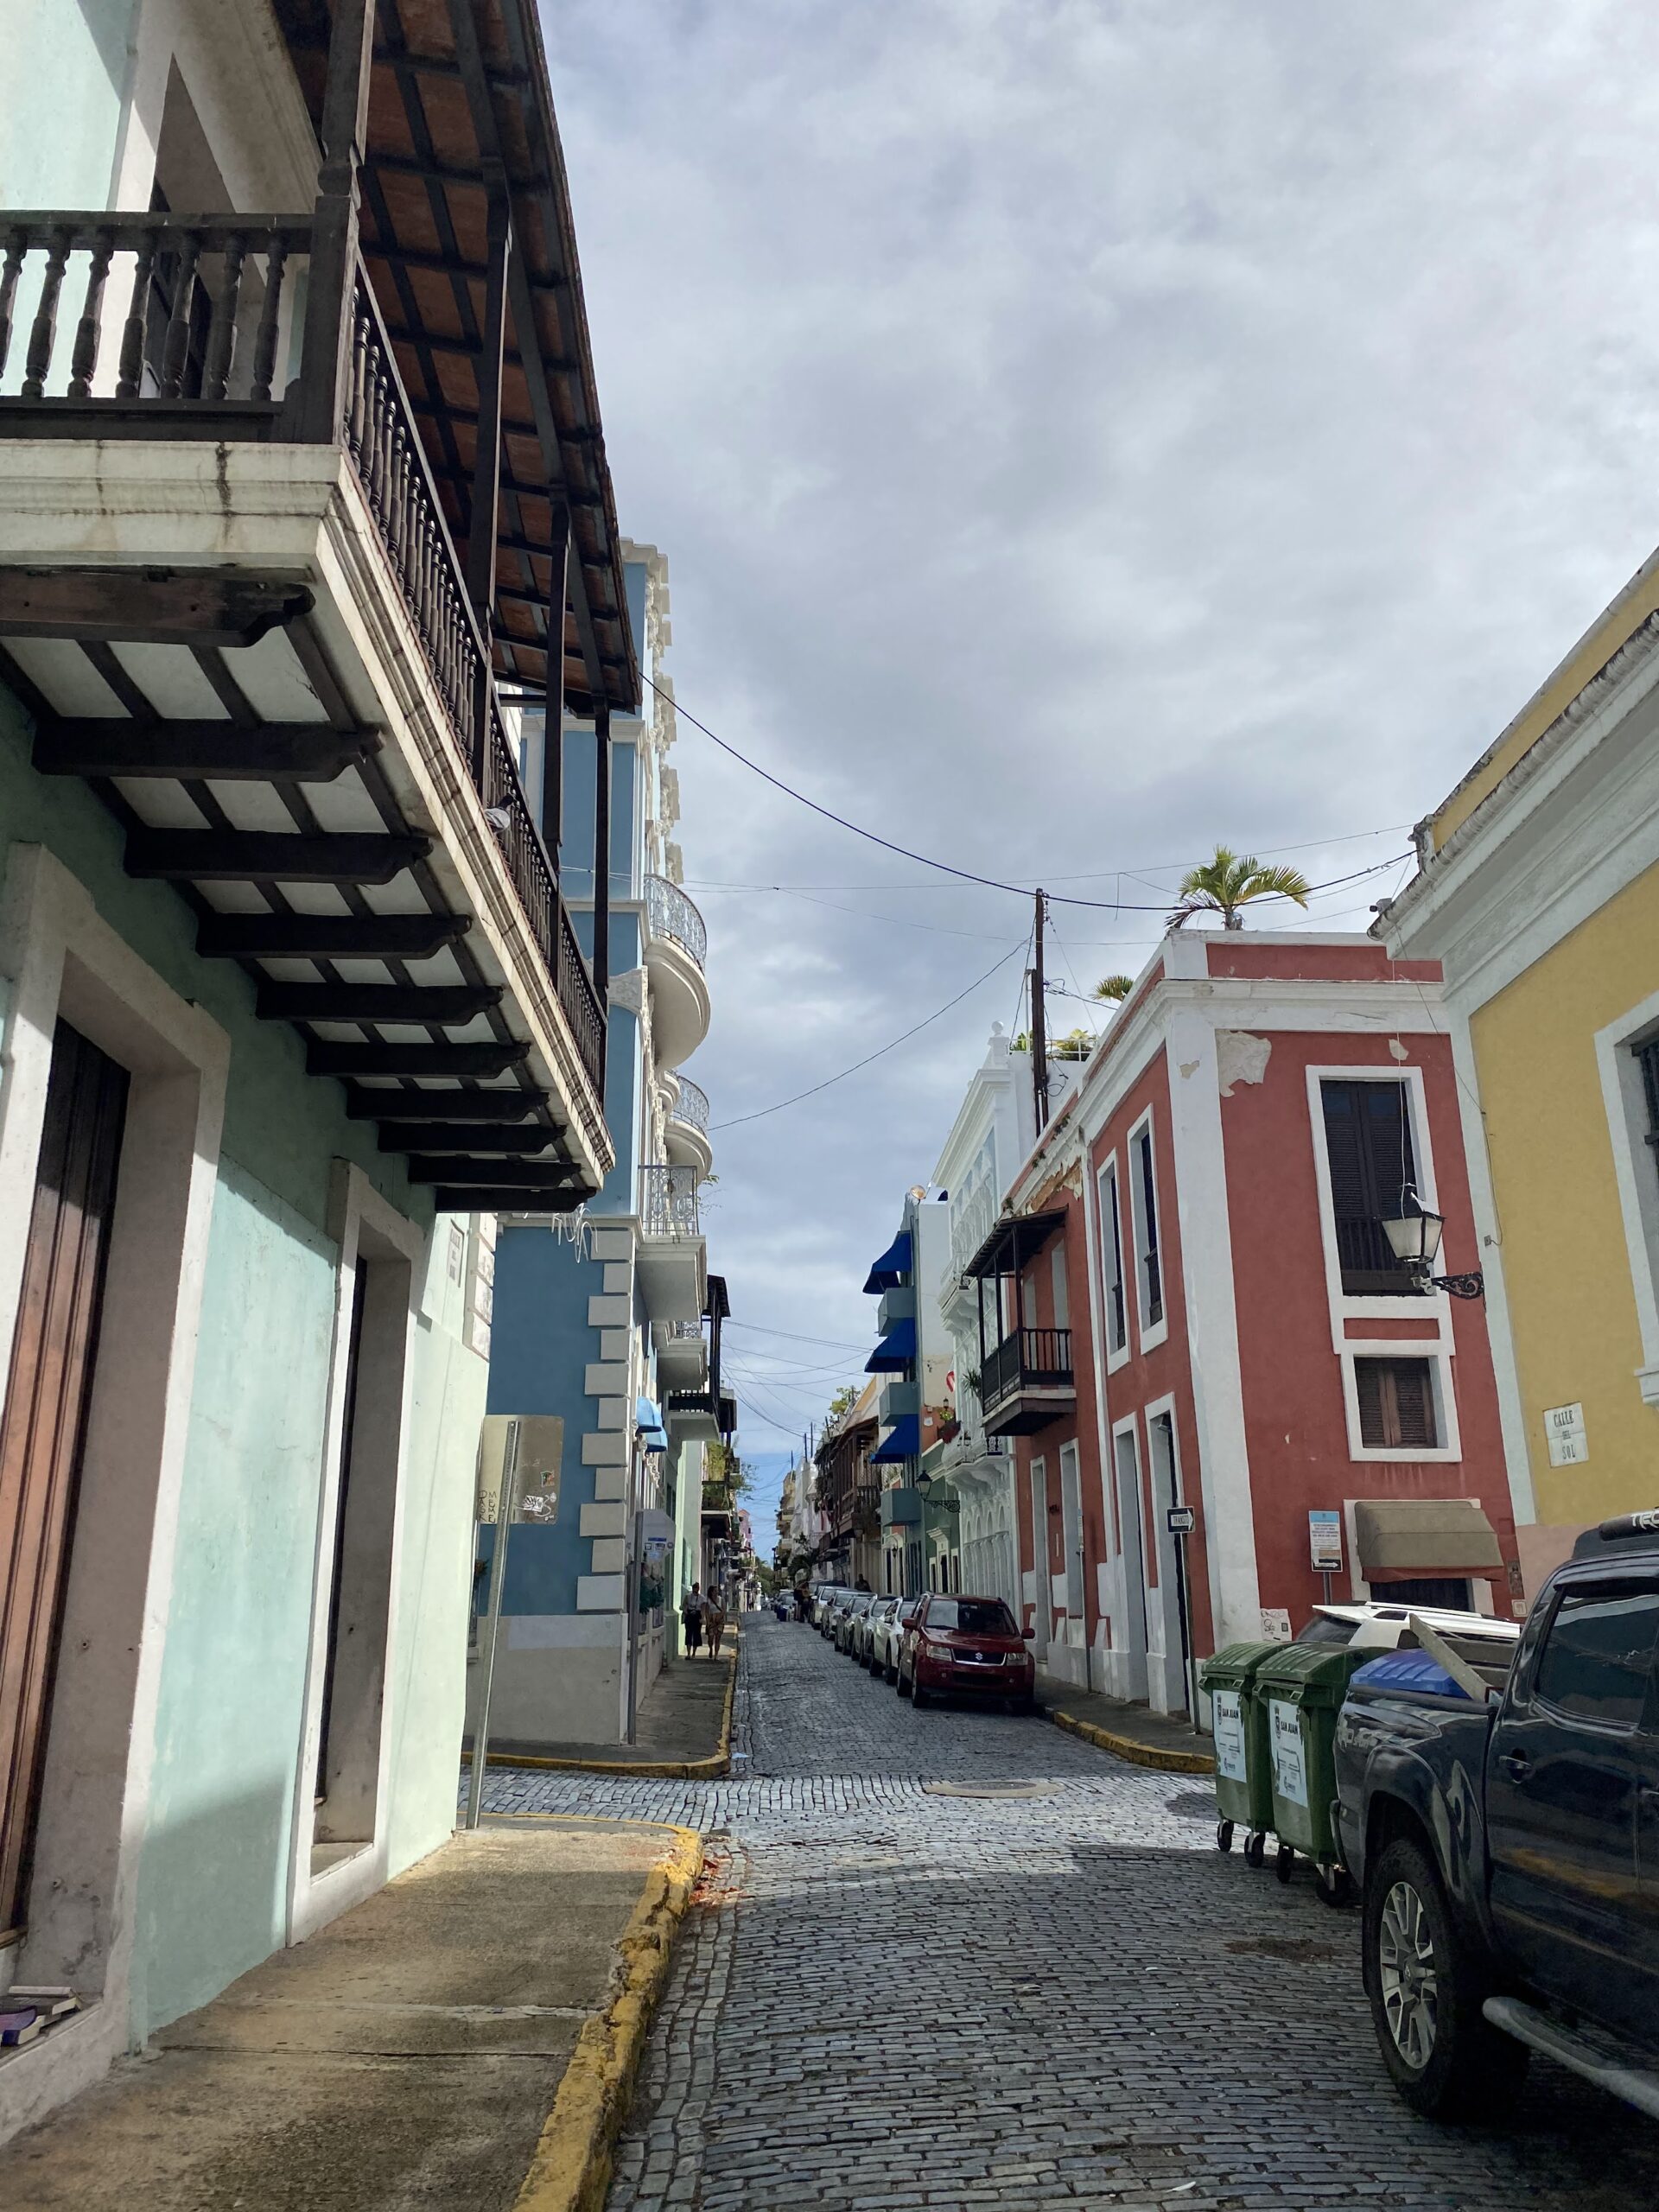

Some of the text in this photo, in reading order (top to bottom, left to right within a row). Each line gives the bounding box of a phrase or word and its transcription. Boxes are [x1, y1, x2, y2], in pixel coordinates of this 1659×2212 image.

[1554, 1409, 1574, 1427] CALLE
[1561, 1444, 1576, 1459] SOL
[1229, 1709, 1239, 1719] JUAN
[1287, 1723, 1299, 1735] JUAN
